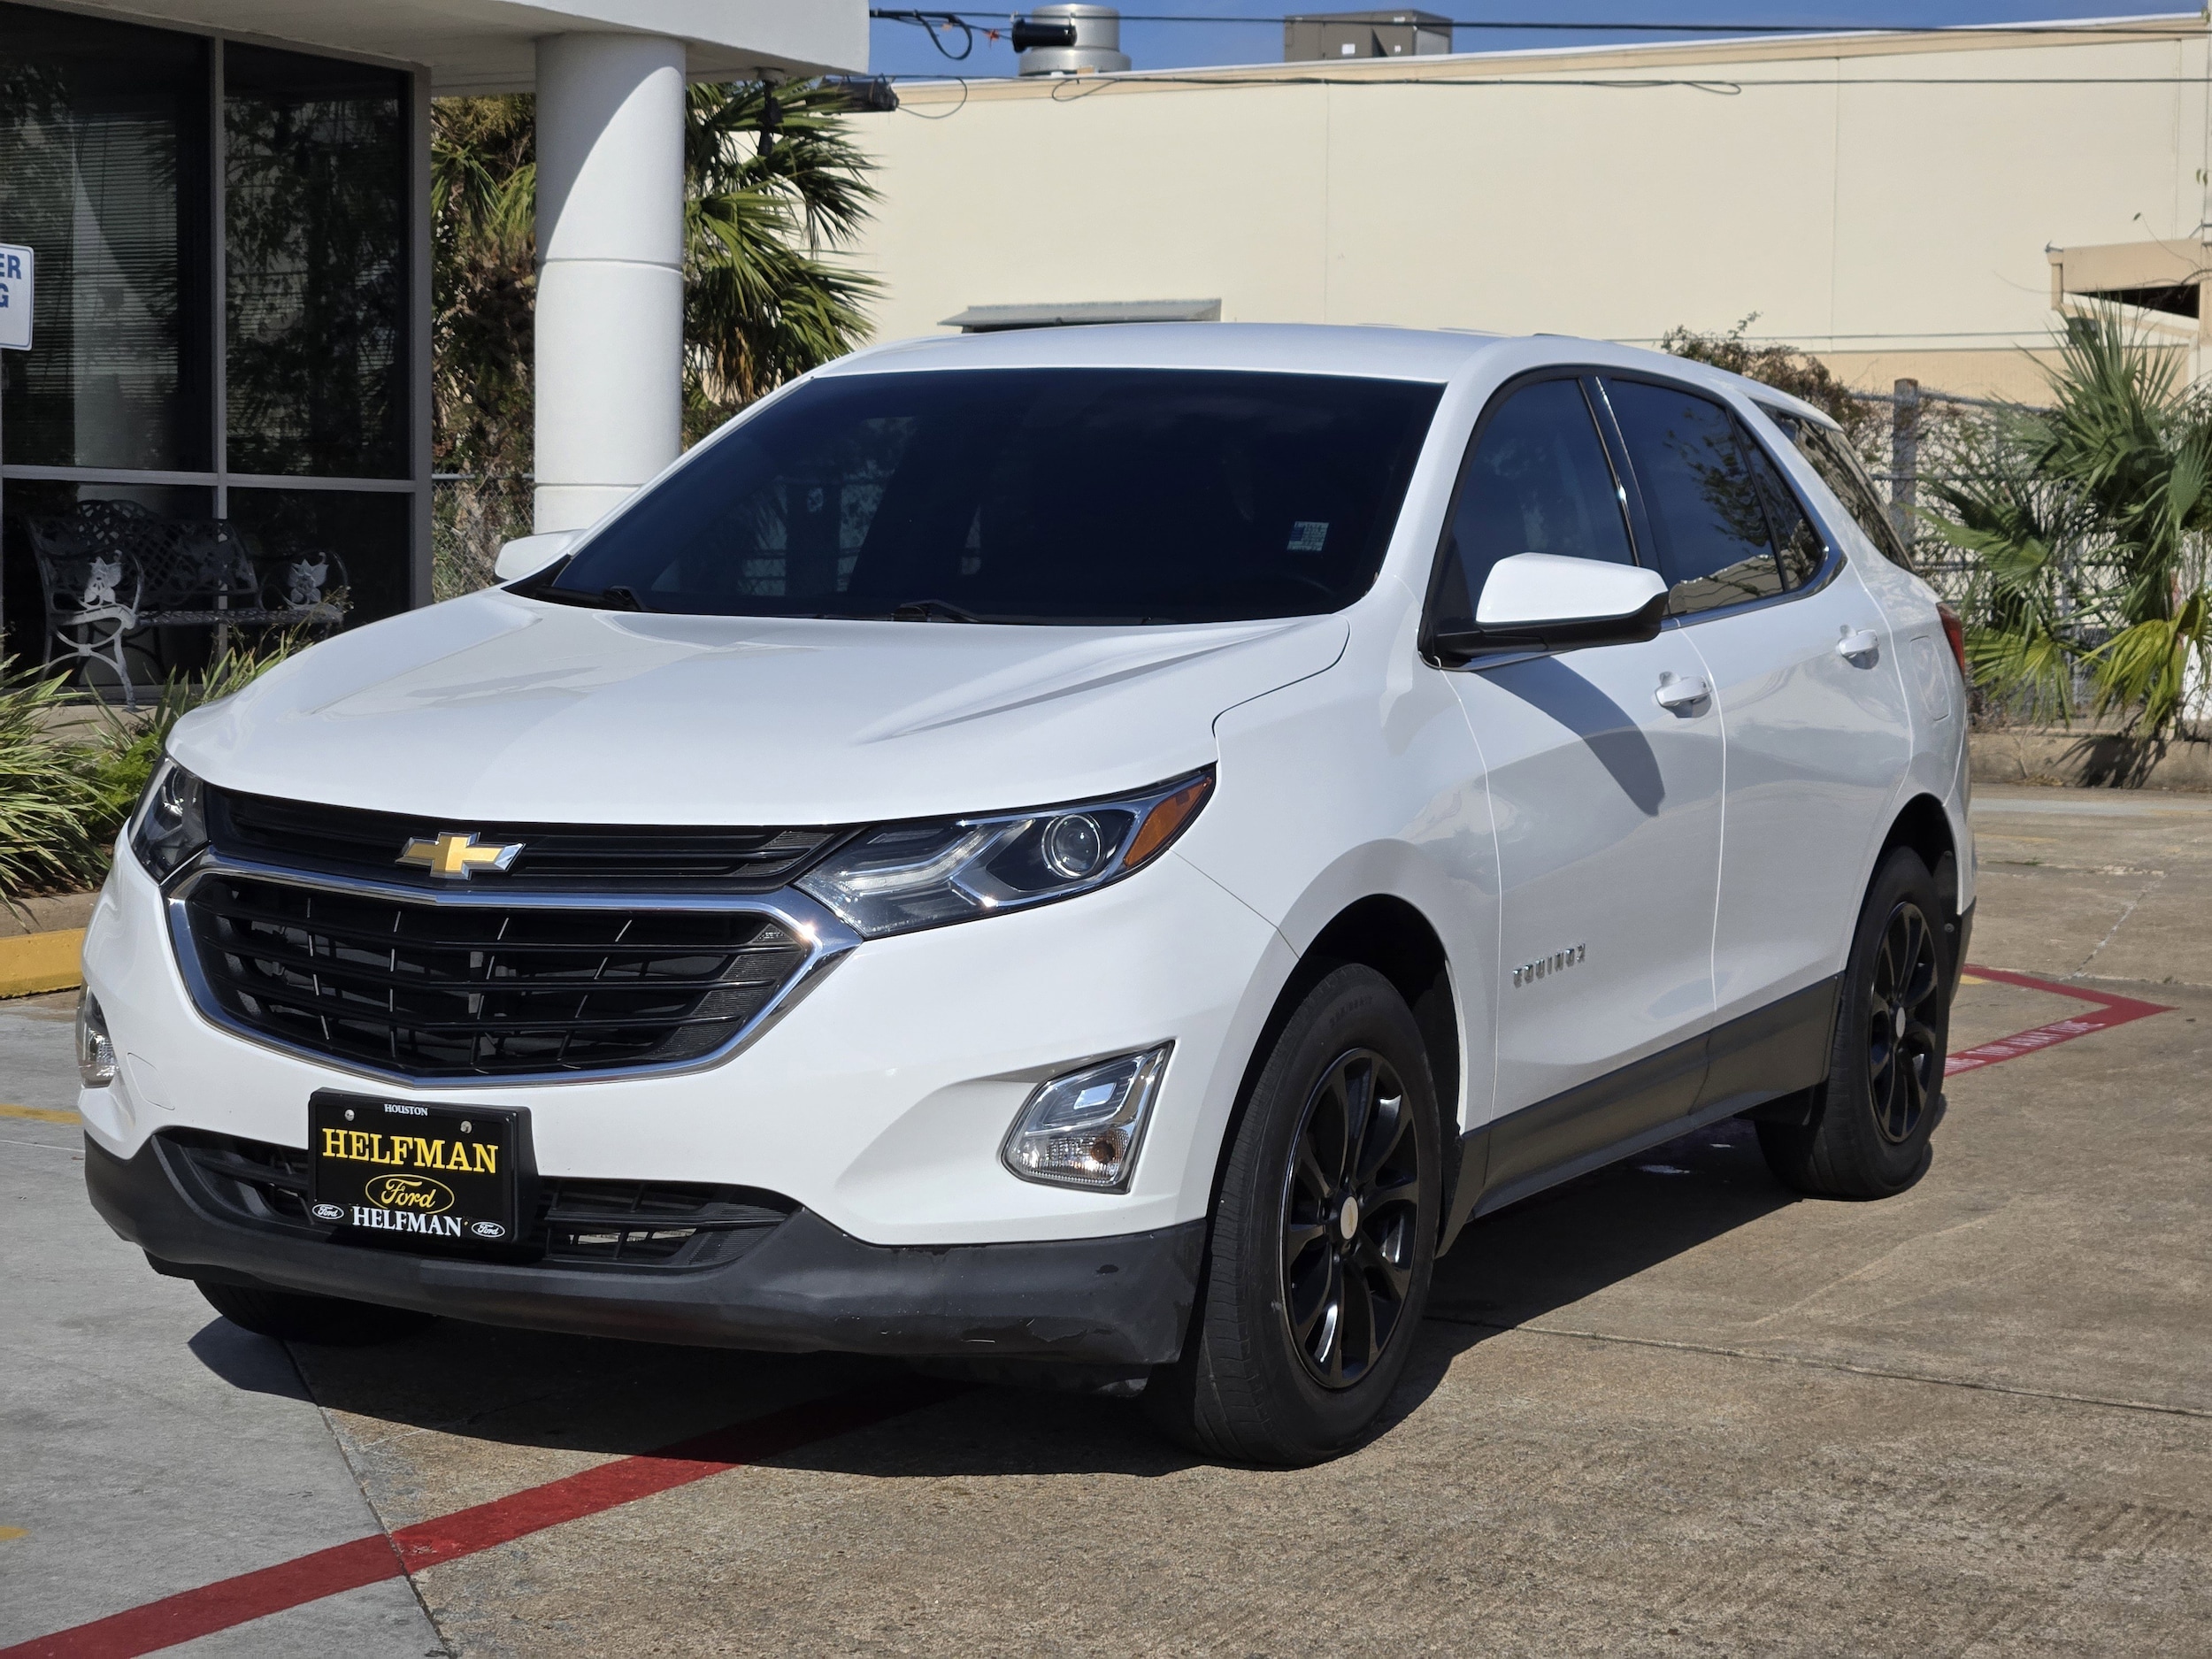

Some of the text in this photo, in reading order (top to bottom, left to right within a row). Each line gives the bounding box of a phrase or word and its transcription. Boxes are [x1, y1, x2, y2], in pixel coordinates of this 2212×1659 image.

[384, 1103, 428, 1117] HOUSTON
[322, 1127, 499, 1174] HELFMAN
[380, 1178, 436, 1209] Ford
[351, 1205, 463, 1238] HELFMAN
